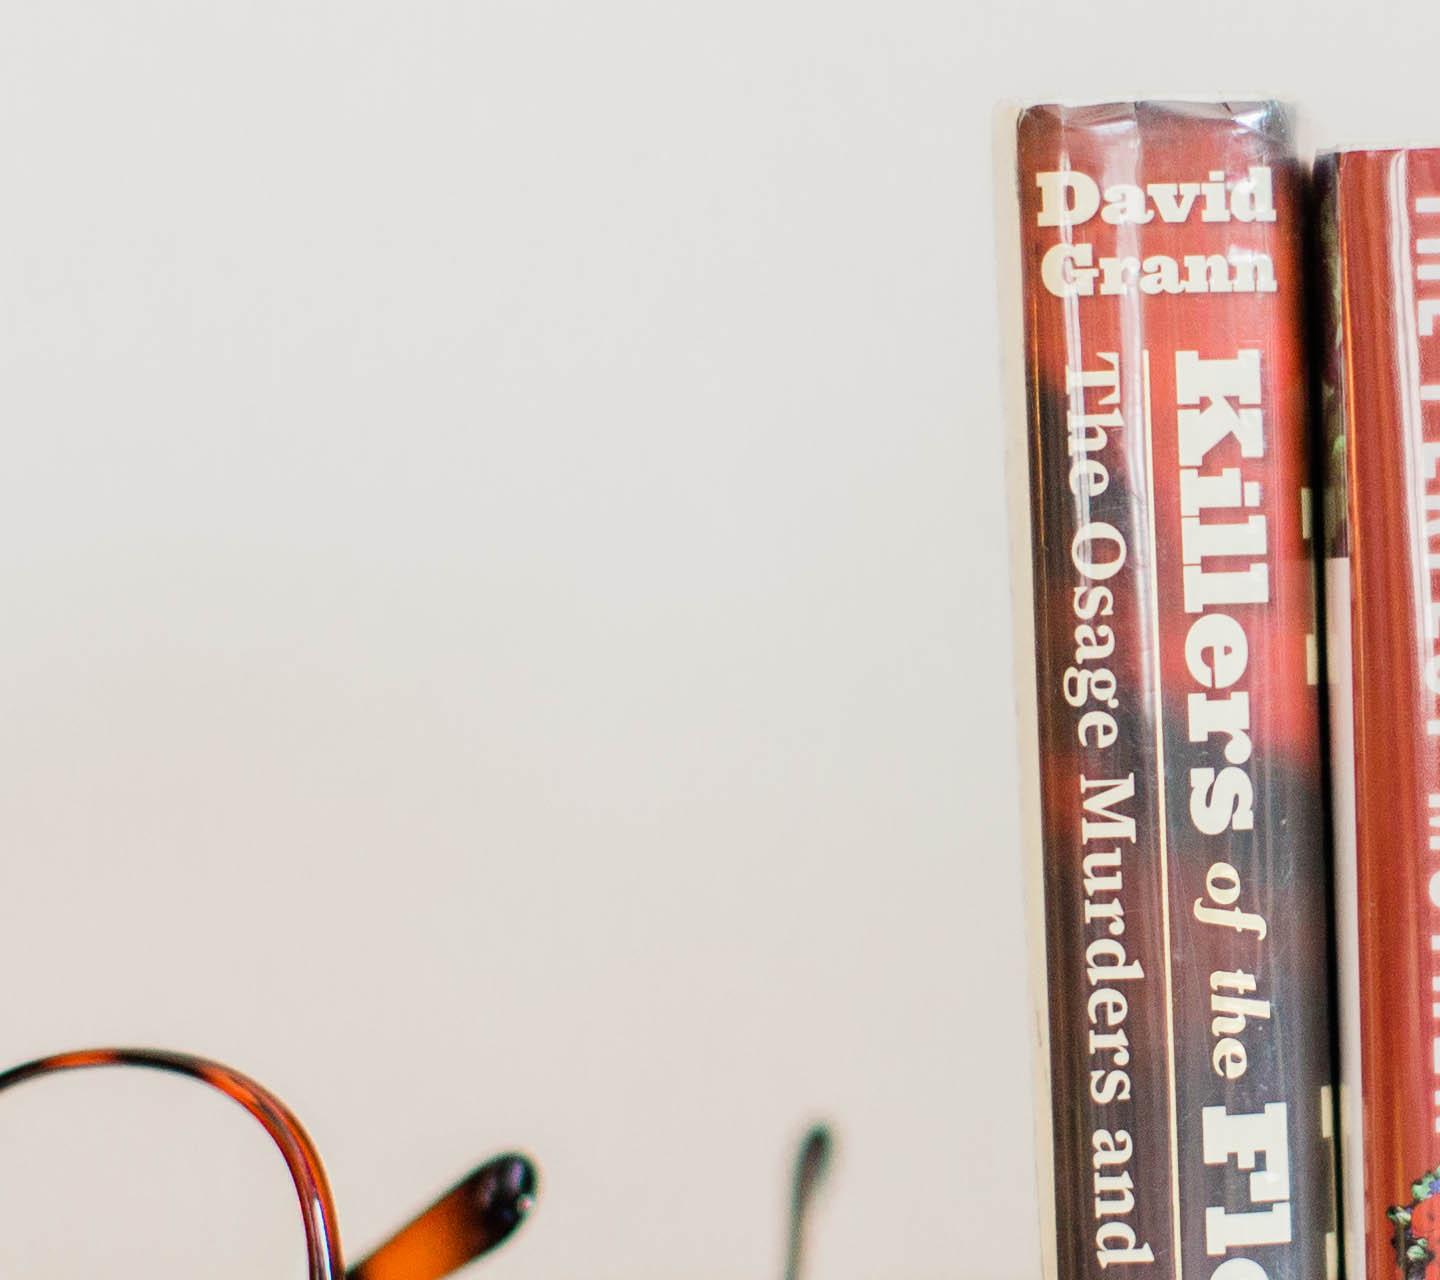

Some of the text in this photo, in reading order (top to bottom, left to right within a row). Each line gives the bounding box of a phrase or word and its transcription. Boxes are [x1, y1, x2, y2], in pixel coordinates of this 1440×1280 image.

[1036, 167, 1276, 227] David
[1041, 245, 1276, 297] Grann
[1065, 351, 1124, 498] The
[1064, 521, 1126, 750] Osage
[1175, 348, 1269, 835] Killers
[1079, 773, 1145, 1104] Murders
[1194, 862, 1266, 940] of
[1209, 969, 1270, 1079] the
[1091, 1128, 1154, 1268] and
